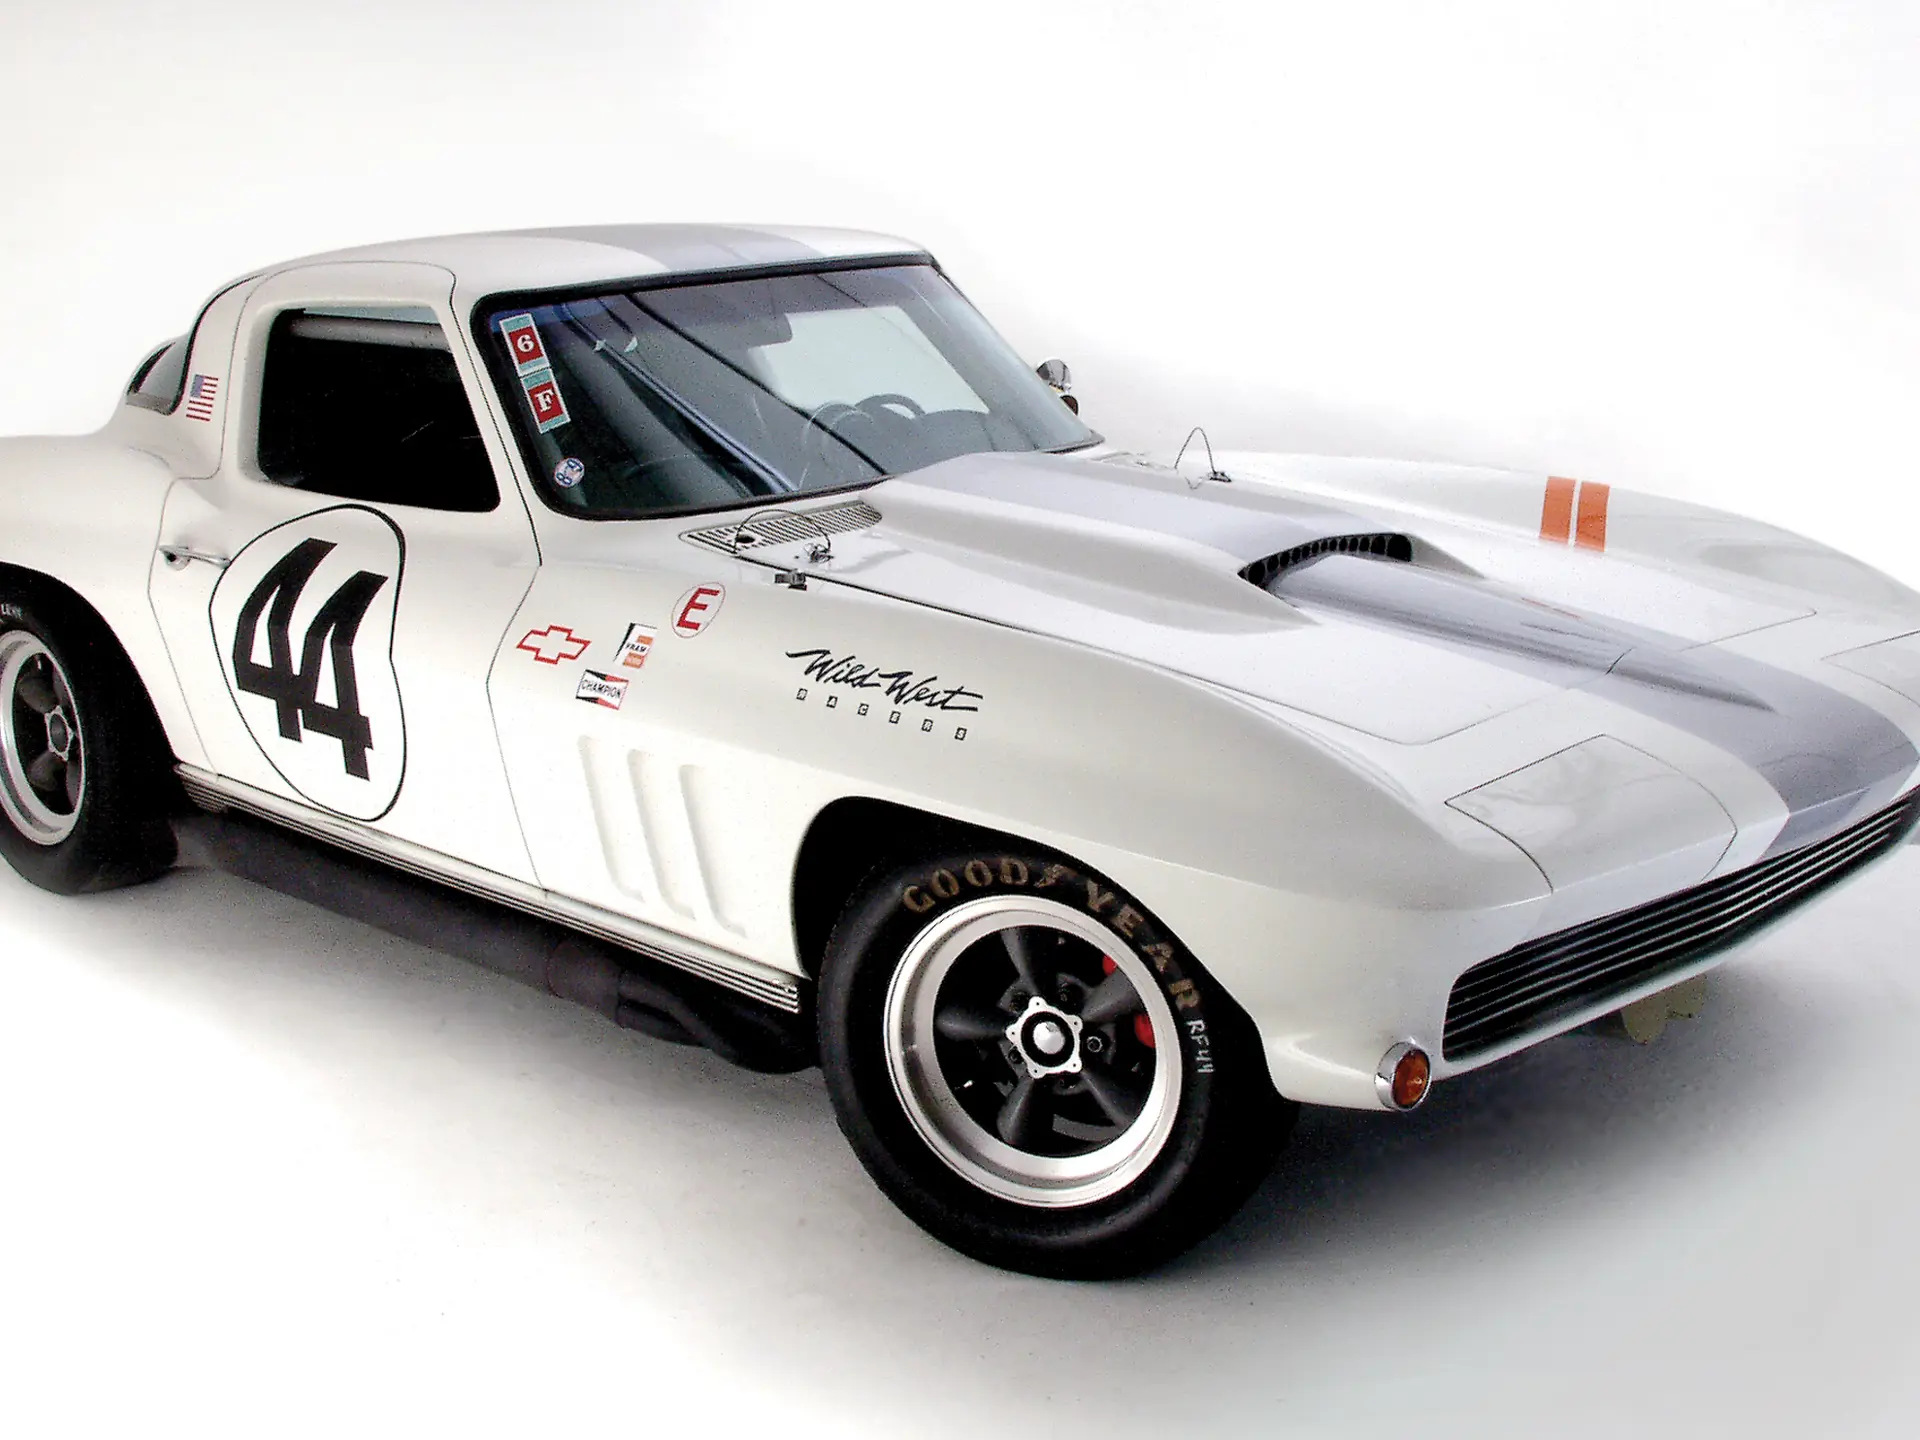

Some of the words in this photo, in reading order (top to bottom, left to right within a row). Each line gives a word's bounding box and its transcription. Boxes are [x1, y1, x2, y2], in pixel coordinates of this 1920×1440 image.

[517, 334, 535, 353] 6
[534, 389, 554, 413] F
[676, 587, 720, 630] E
[232, 537, 389, 781] 44
[581, 679, 621, 699] CHAMPION
[785, 649, 881, 688] Wild
[878, 671, 983, 712] West
